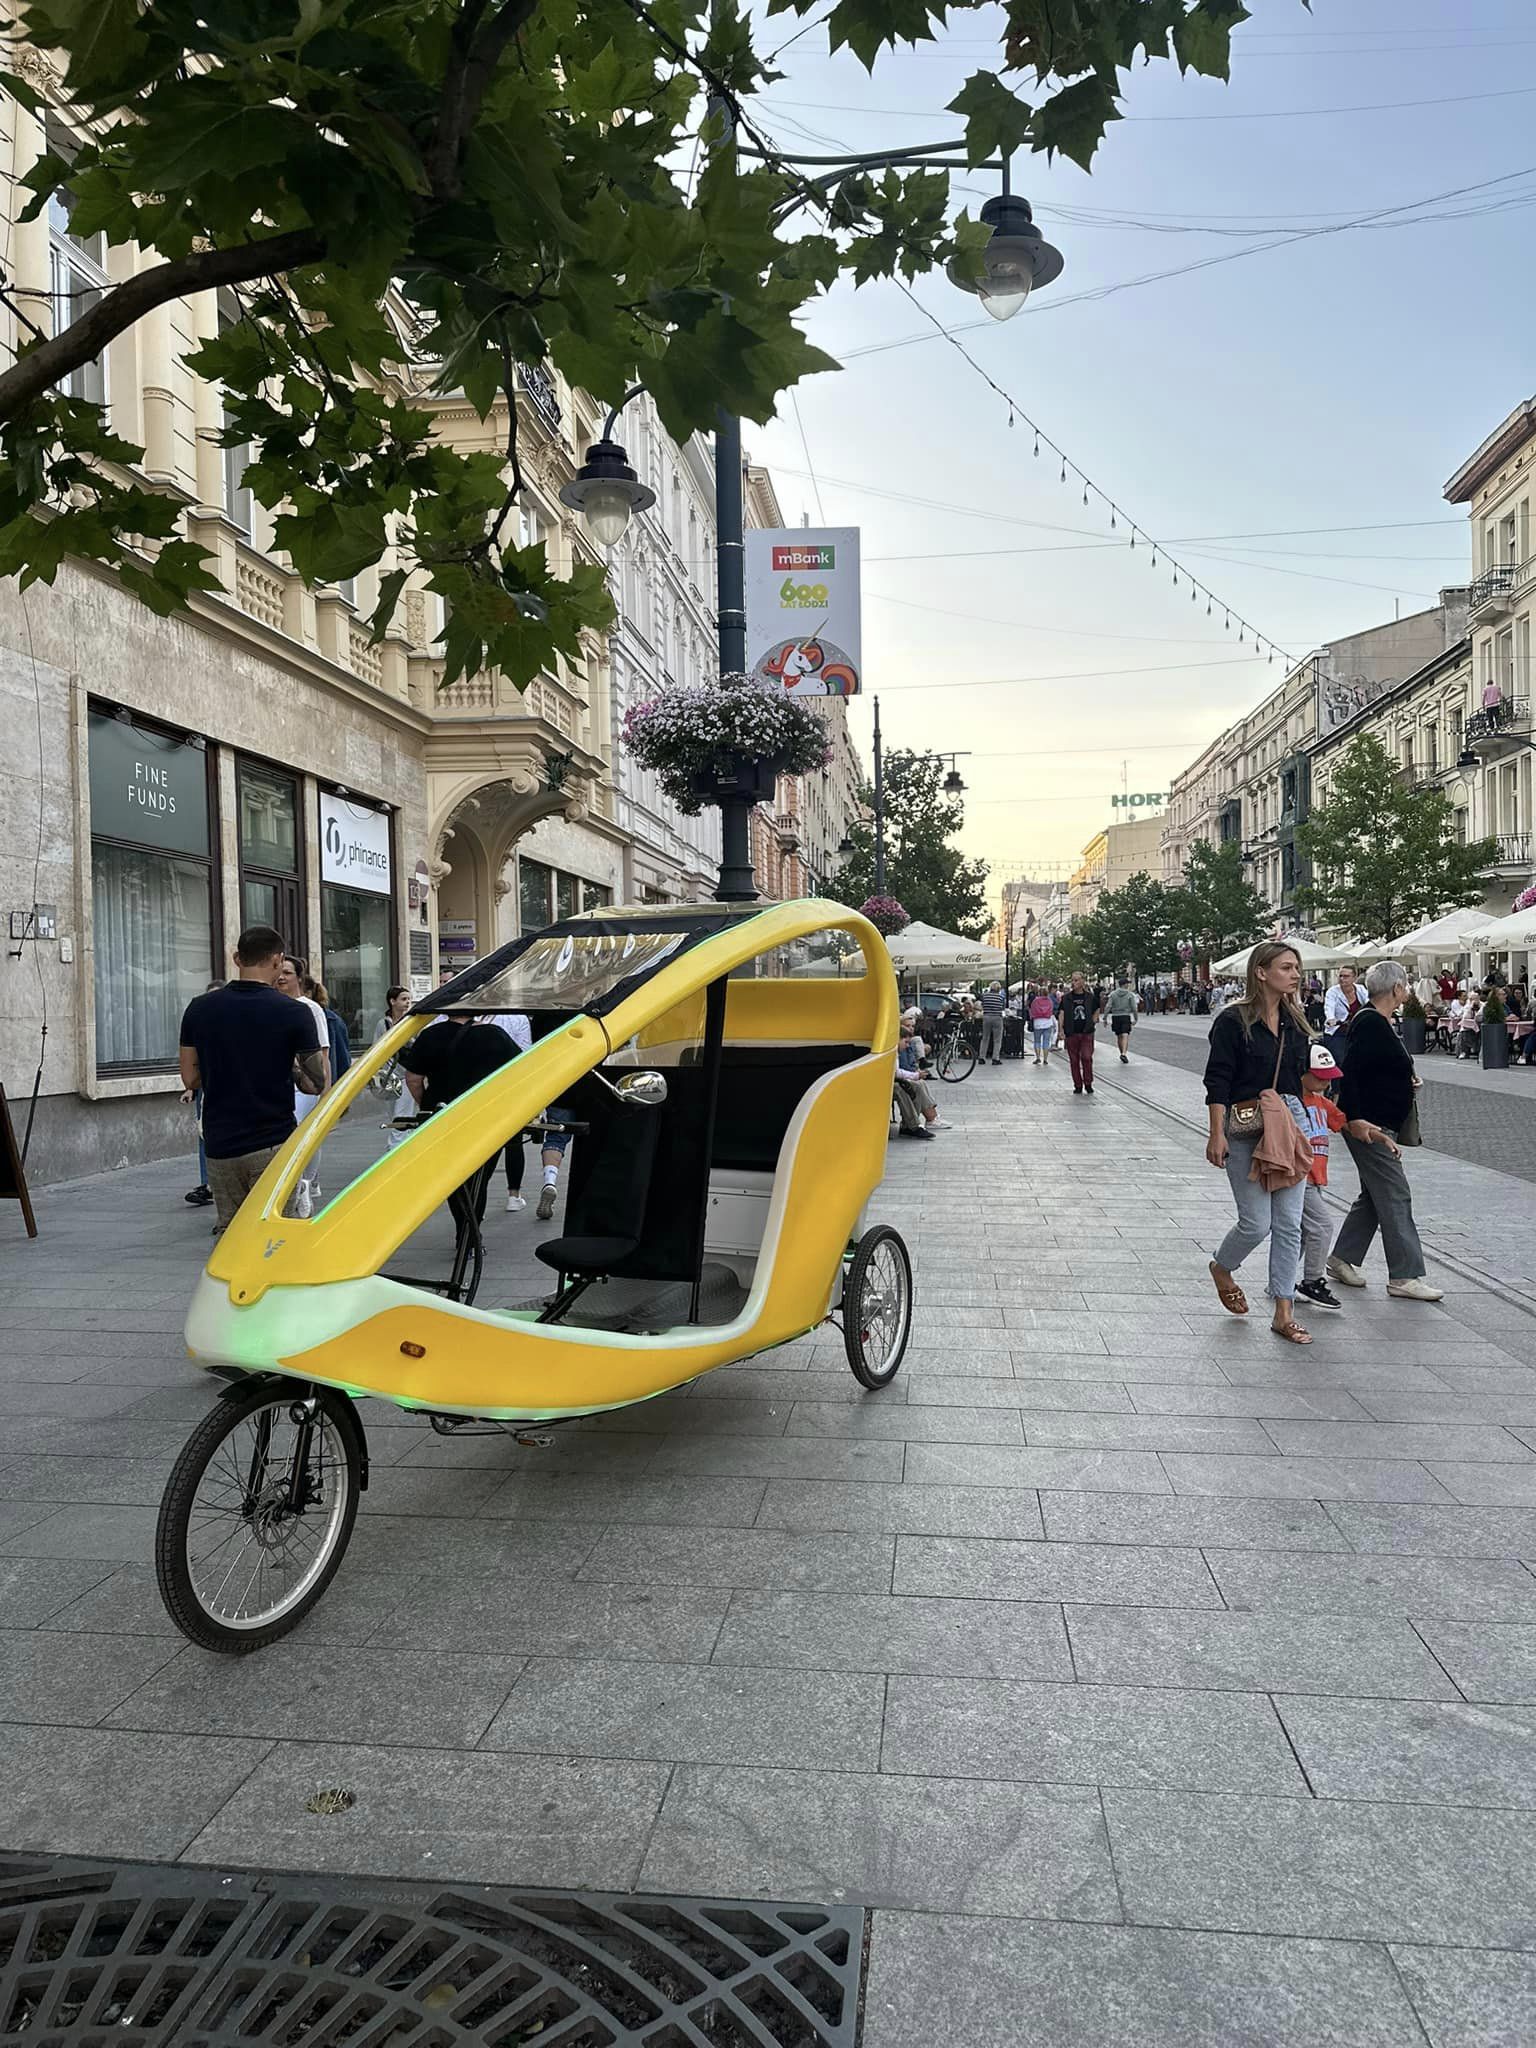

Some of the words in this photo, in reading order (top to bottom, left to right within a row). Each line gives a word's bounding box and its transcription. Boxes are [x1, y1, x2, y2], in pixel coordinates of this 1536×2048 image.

[778, 552, 829, 565] mBank
[780, 577, 828, 601] 600
[135, 761, 168, 788] FINE
[128, 784, 176, 813] FUNDS
[349, 841, 387, 870] phinance
